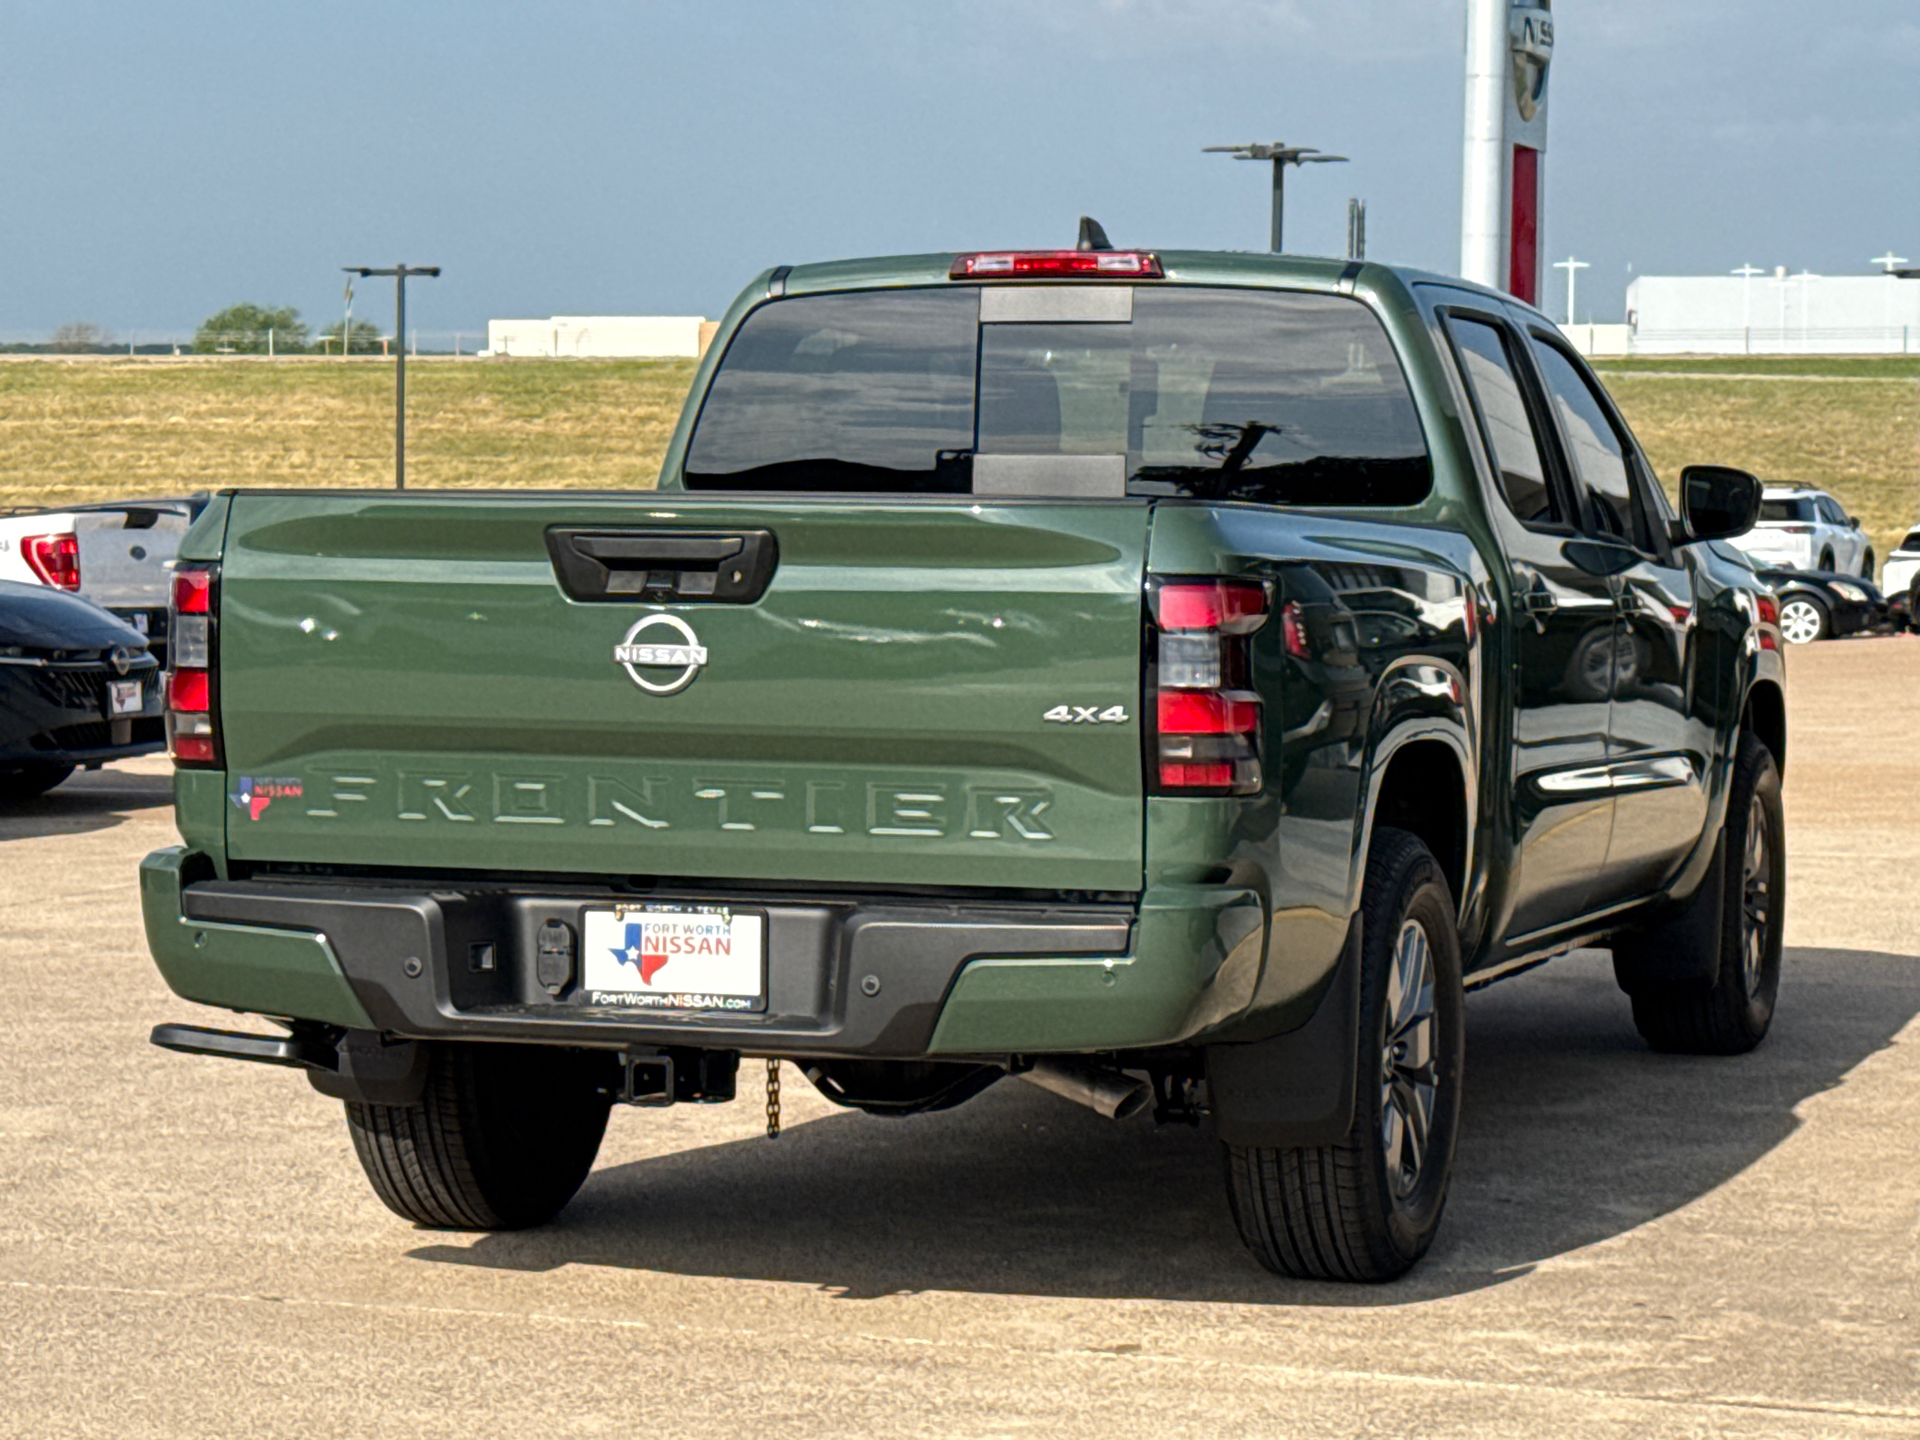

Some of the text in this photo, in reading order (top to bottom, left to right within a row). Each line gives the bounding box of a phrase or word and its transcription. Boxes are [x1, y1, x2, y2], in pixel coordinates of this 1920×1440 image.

[615, 647, 707, 663] NISSAN
[254, 785, 303, 797] NISSAN
[306, 766, 1055, 840] FRONTIER
[645, 923, 731, 936] FORT WORTH
[645, 936, 731, 956] NISSAN
